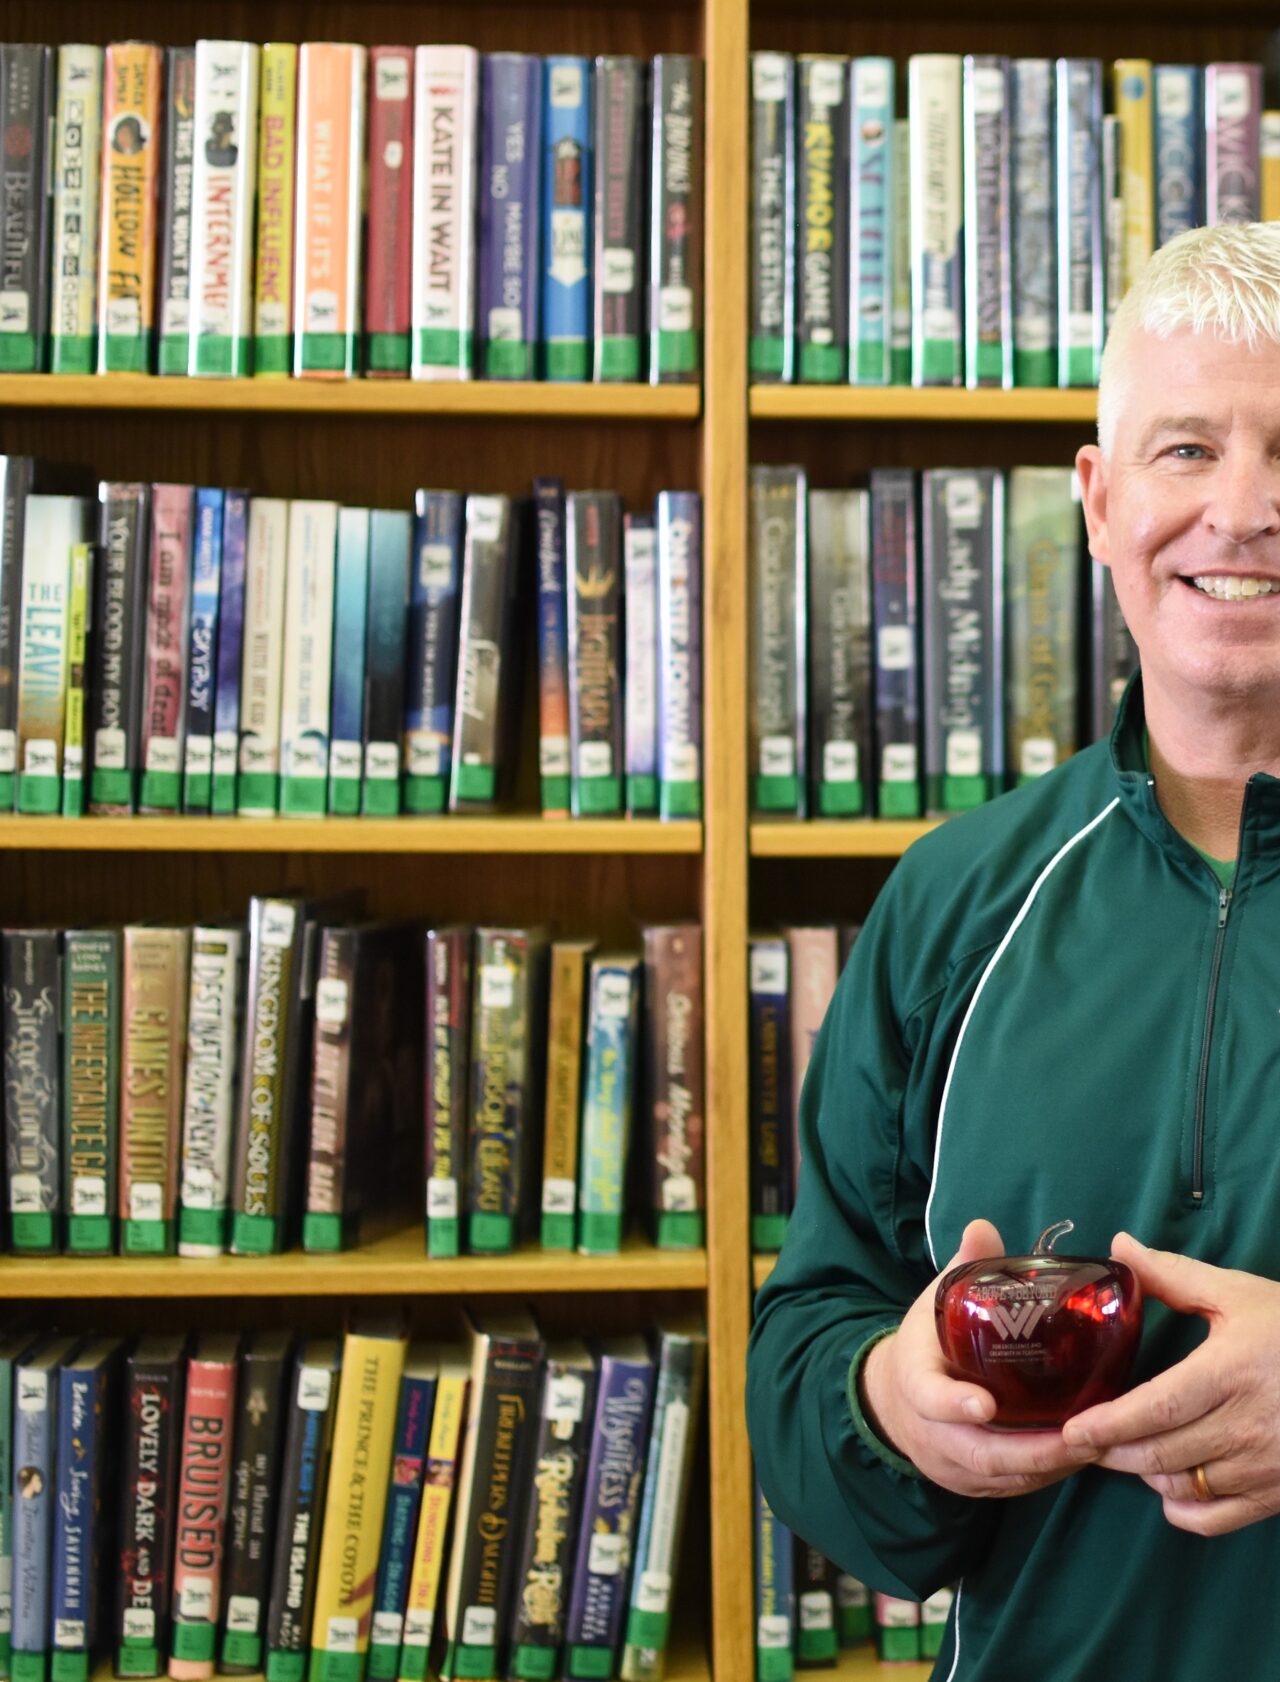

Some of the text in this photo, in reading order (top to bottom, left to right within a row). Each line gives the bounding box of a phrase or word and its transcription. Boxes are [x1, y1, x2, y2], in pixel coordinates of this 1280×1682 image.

[175, 120, 192, 159] THIS
[264, 114, 285, 169] BAD
[504, 121, 525, 163] YES
[111, 164, 145, 258] HOLLOW
[174, 164, 190, 211] BOOK
[311, 118, 333, 279] WHAT IF IT'S
[429, 107, 453, 293] KATE IN WAIT
[490, 164, 509, 200] NO
[259, 178, 283, 303] INFLUENC
[805, 121, 833, 322] RUMOR GAME
[502, 276, 523, 306] SO
[108, 517, 130, 571] YOUR
[158, 551, 174, 581] am
[159, 531, 180, 542] I
[28, 583, 62, 601] THE
[105, 577, 126, 651] BLOOD
[24, 606, 62, 727] LEAVIN
[103, 653, 122, 686] MY
[128, 1006, 170, 1101] GAMES
[193, 965, 225, 1096] DESTINATION
[70, 980, 108, 1177] THE INHERITANCE GA
[245, 944, 283, 1216] KINGDOM OF SOULS
[361, 1357, 380, 1395] THE
[139, 1392, 161, 1473] LOVELY
[353, 1398, 376, 1471] PRINCE
[181, 1415, 224, 1570] BRUISED
[253, 1453, 267, 1477] my
[349, 1473, 366, 1490] &
[134, 1480, 156, 1543] DARK
[346, 1491, 366, 1530] THE
[64, 1523, 83, 1609] SAVANNAH
[136, 1546, 151, 1576] AND
[286, 1511, 311, 1609] THE ISLAND
[132, 1580, 152, 1608] DE
